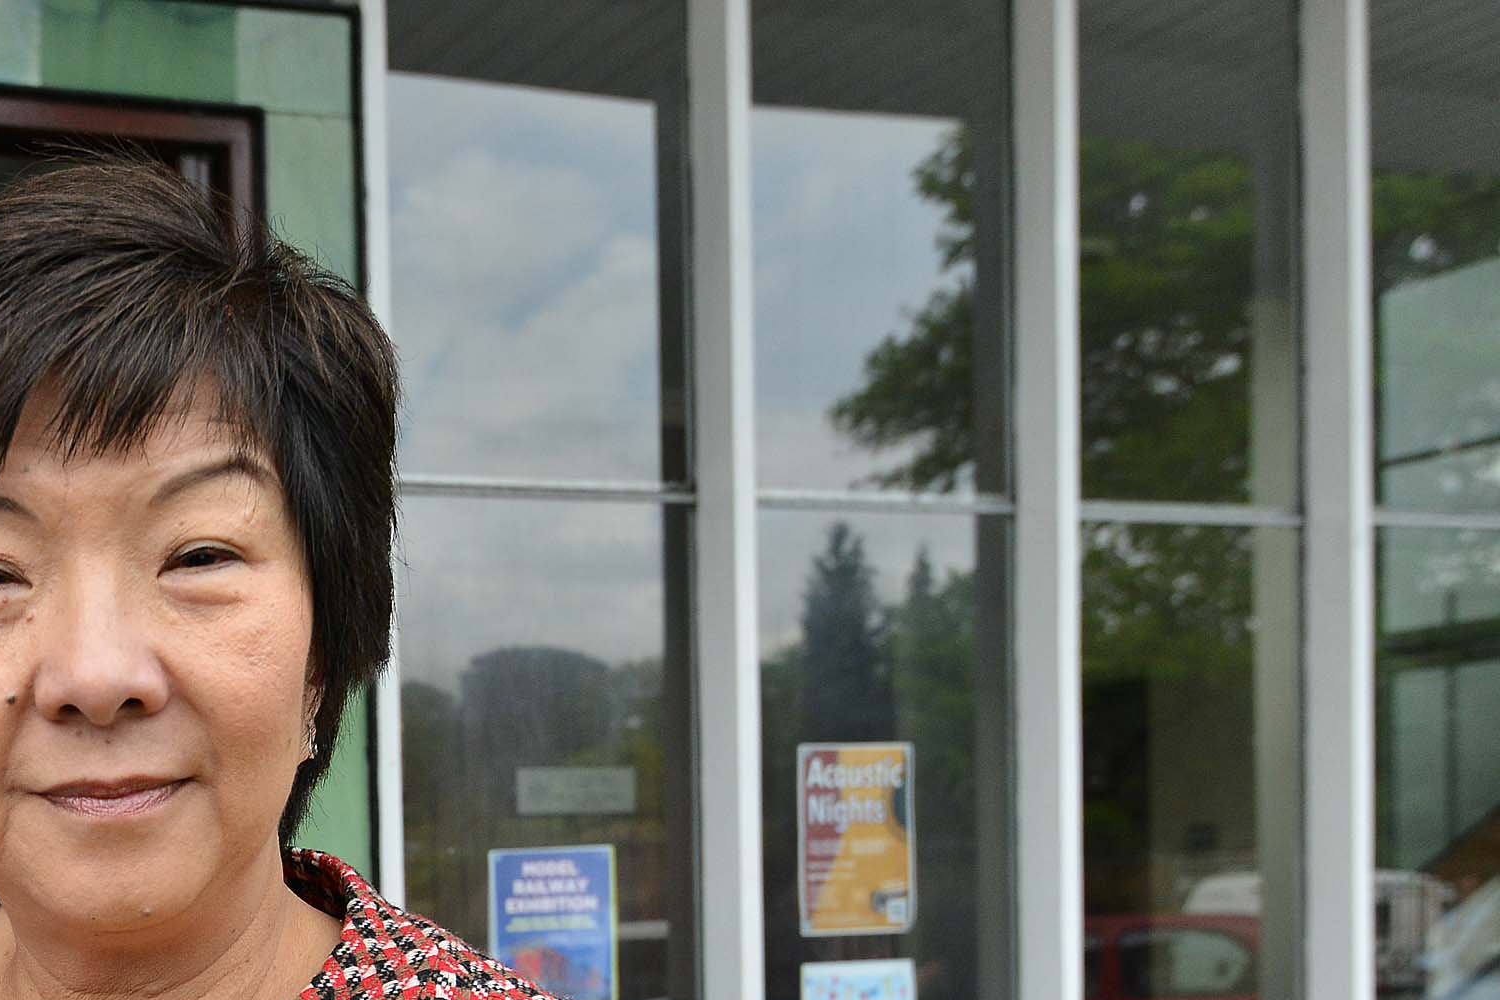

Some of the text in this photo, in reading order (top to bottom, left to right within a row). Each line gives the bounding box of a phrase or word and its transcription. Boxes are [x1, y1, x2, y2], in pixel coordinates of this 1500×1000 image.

[807, 757, 904, 789] Acoustic
[808, 794, 886, 833] Nights
[521, 860, 577, 877] MODEL
[512, 878, 590, 896] RAILWAY
